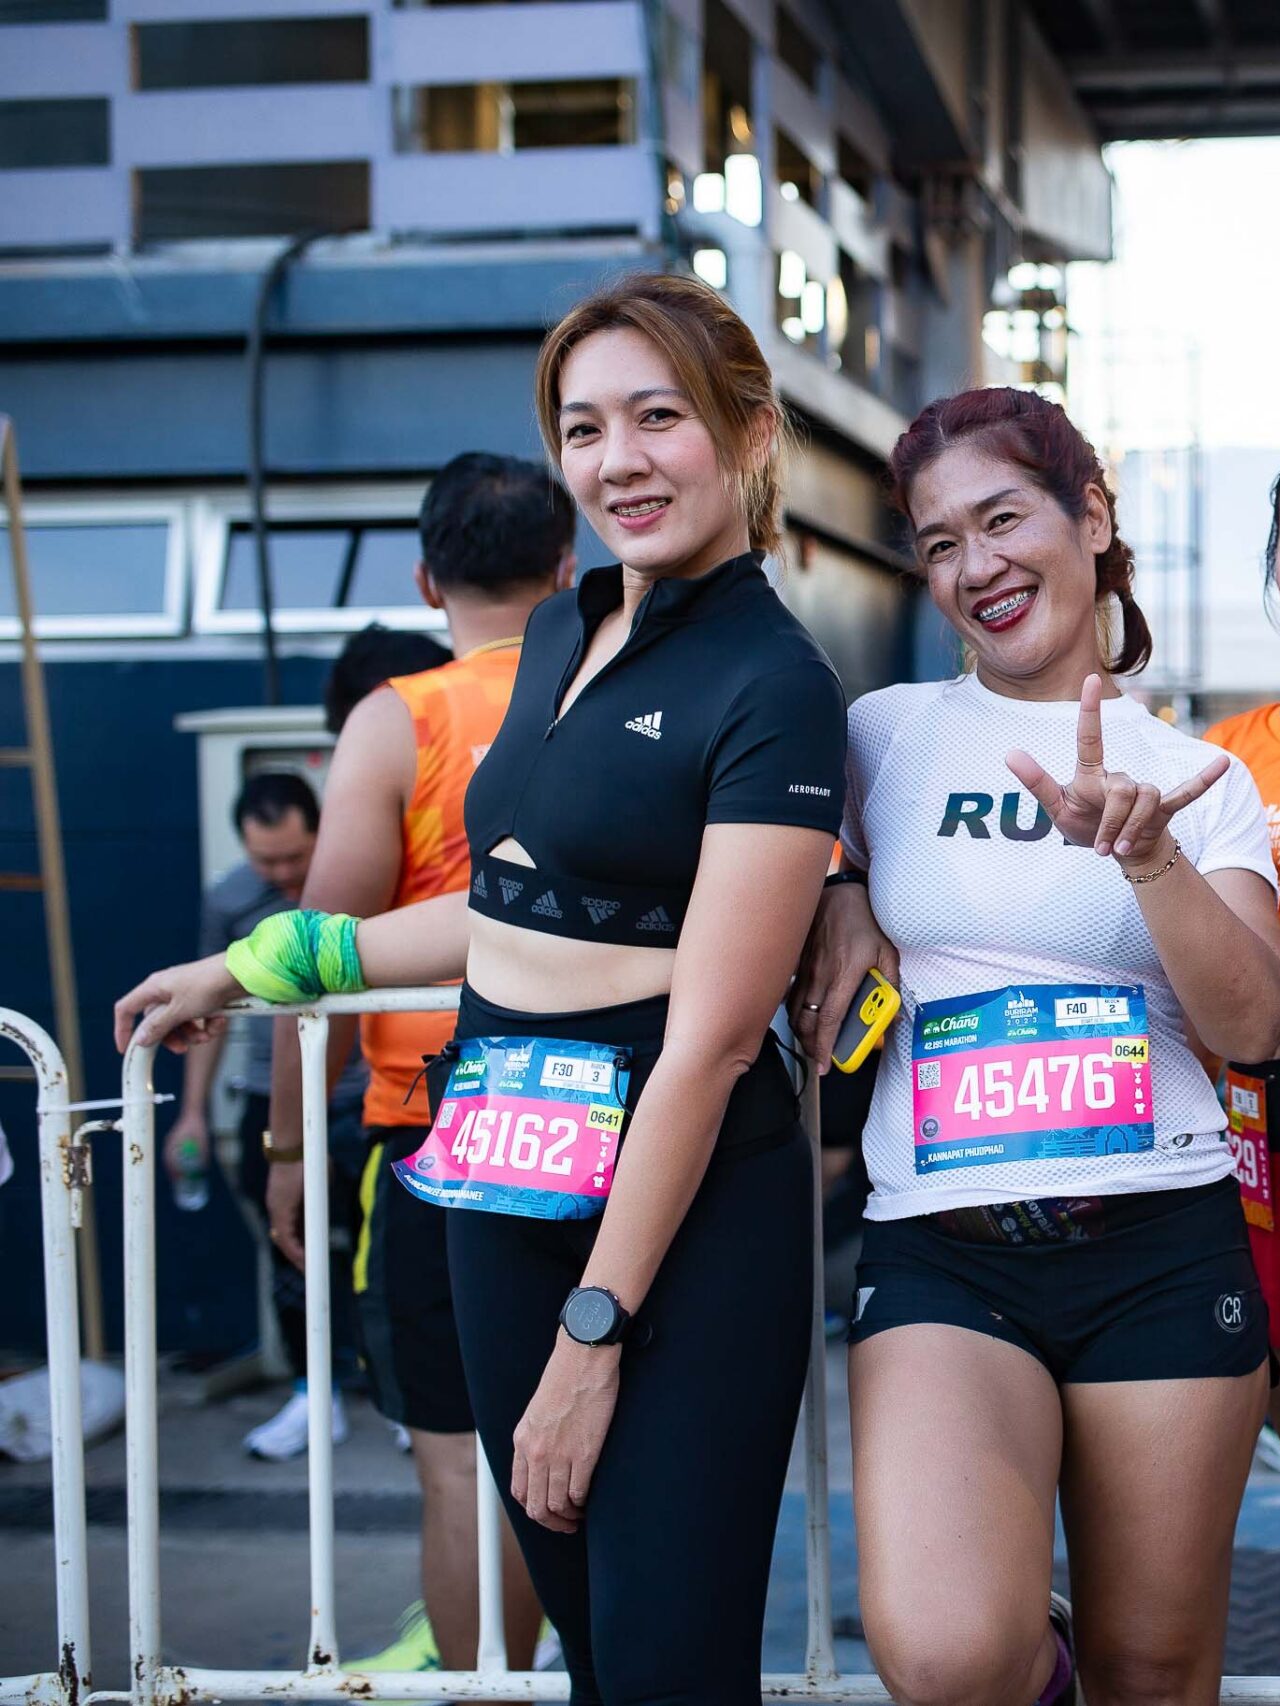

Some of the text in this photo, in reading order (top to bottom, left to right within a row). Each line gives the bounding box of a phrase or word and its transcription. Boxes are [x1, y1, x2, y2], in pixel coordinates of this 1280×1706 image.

[624, 720, 663, 741] adidas
[788, 784, 832, 798] AEROREADY
[937, 791, 1093, 846] RU
[531, 903, 563, 920] adidas
[1004, 1006, 1039, 1017] BURIRAM
[1066, 1002, 1087, 1015] F40
[1109, 1004, 1116, 1014] 2
[940, 1016, 980, 1032] Chang
[944, 1034, 978, 1048] MARATHON
[1114, 1043, 1145, 1058] 0644
[462, 1060, 487, 1077] Chang
[551, 1062, 573, 1077] F30
[592, 1071, 600, 1083] 3
[953, 1052, 1116, 1121] 45476
[590, 1109, 620, 1126] 0641
[450, 1109, 580, 1176] 45162
[1222, 1296, 1241, 1323] CR
